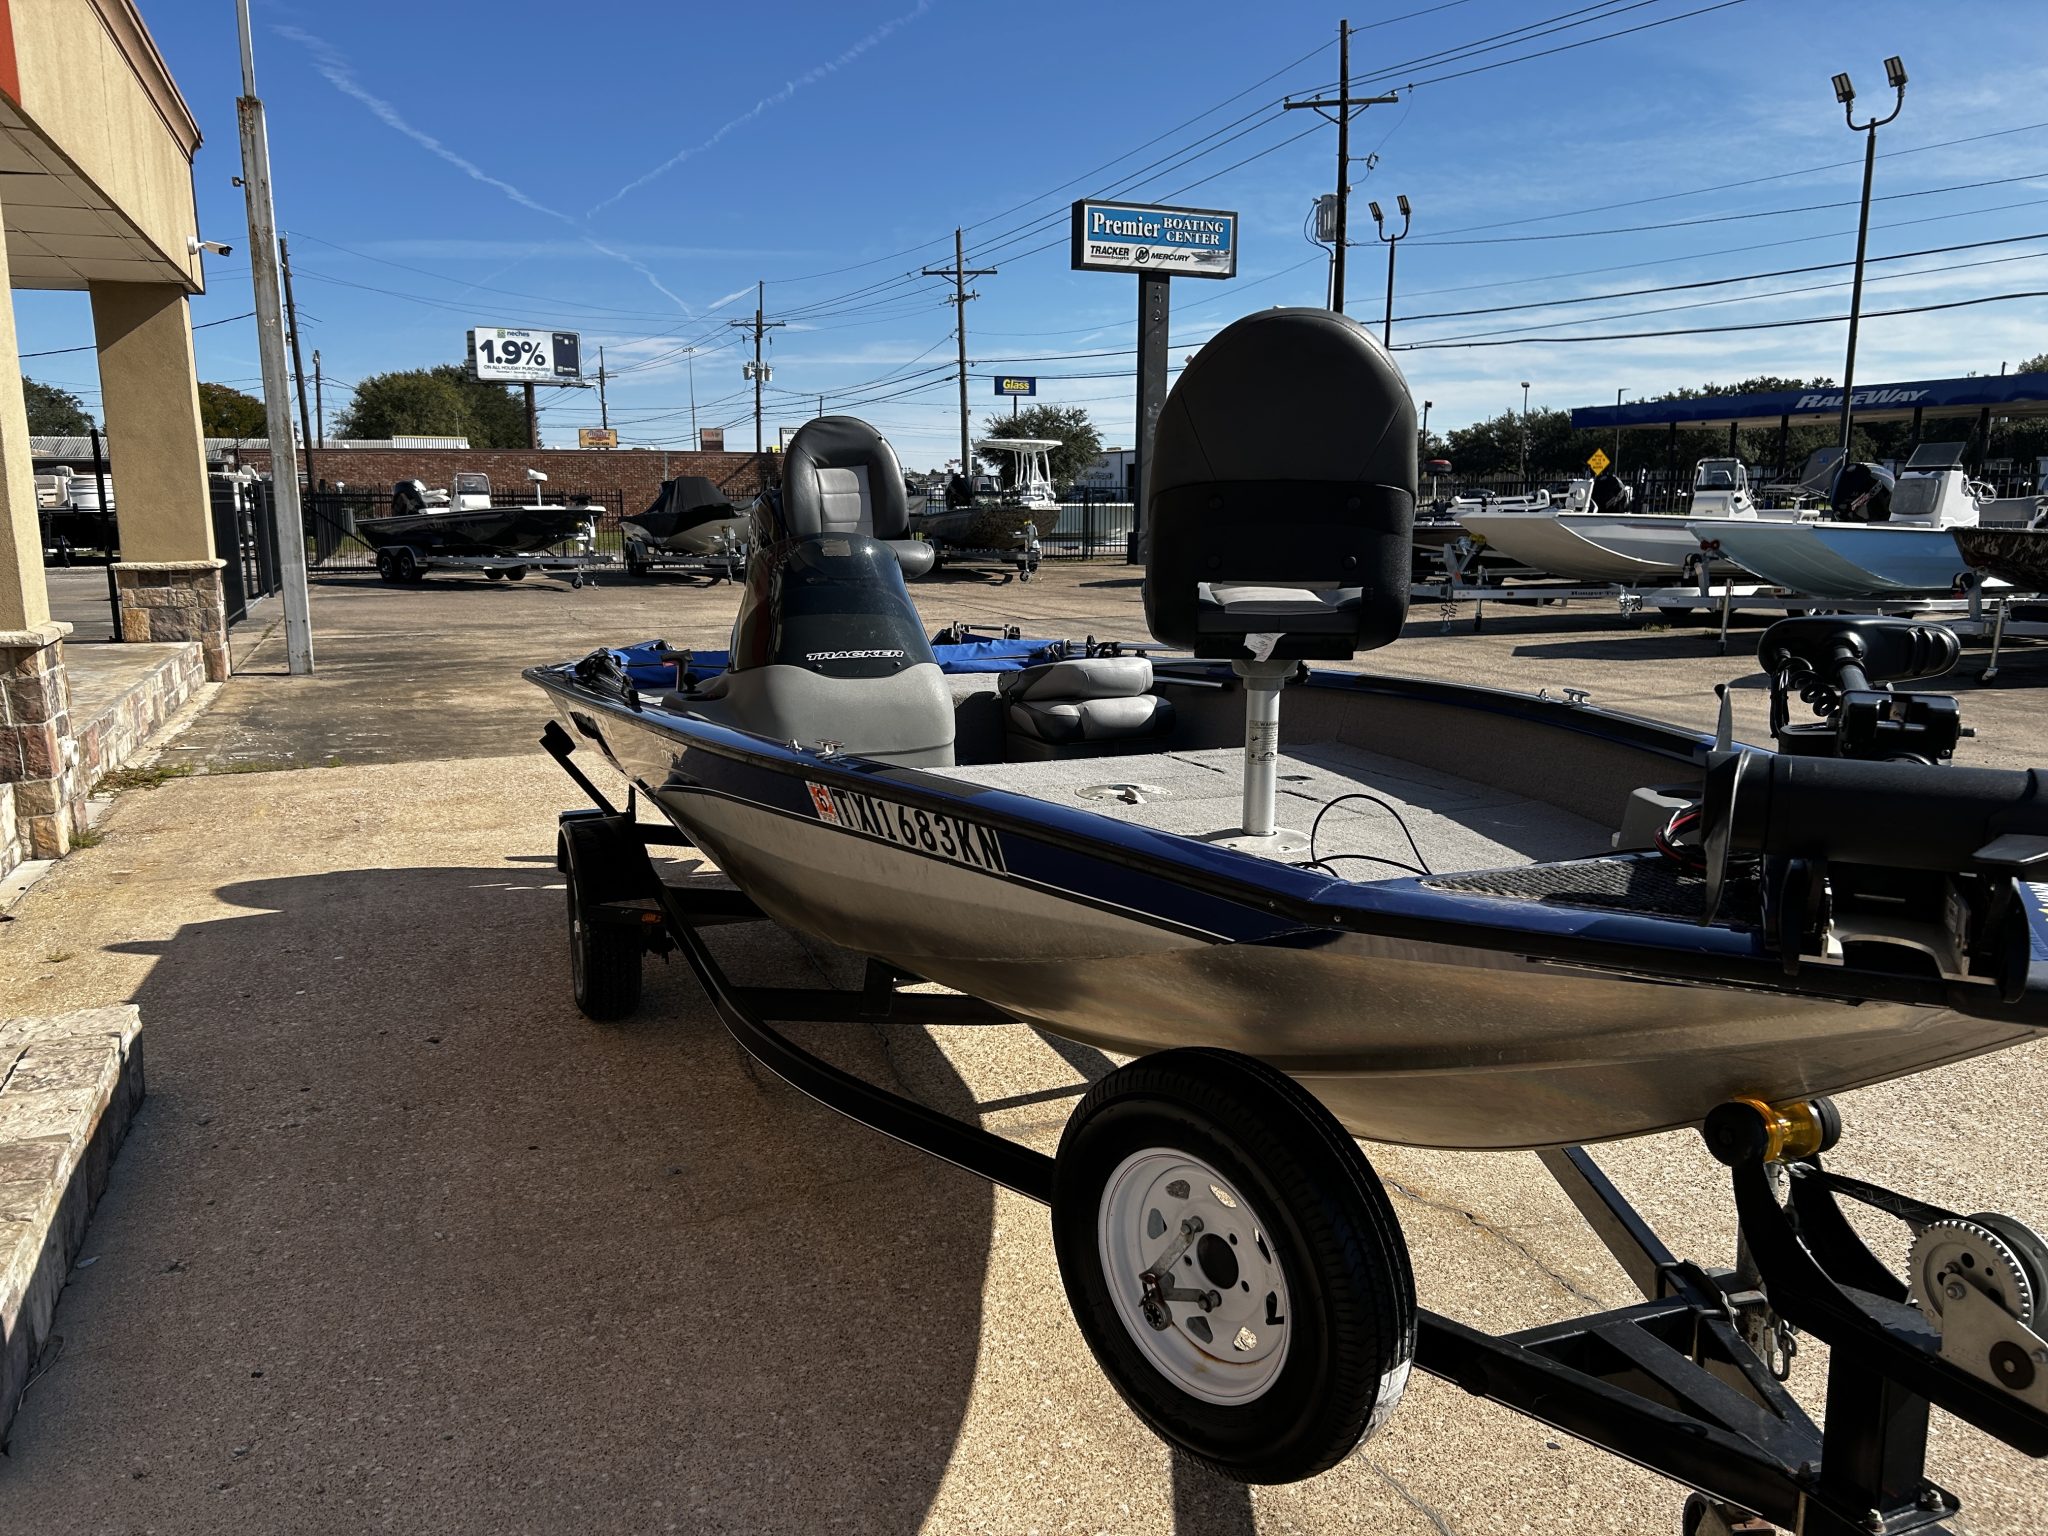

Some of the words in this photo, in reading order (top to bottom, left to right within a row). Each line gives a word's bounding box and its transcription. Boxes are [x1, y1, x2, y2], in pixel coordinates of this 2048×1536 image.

[1092, 212, 1160, 238] Premier
[1163, 217, 1224, 233] BOATING
[1166, 231, 1220, 245] CENTER
[1090, 245, 1129, 257] TRACKER
[1151, 252, 1190, 262] MERCURY
[507, 330, 530, 338] neches
[479, 339, 546, 366] 1.9%
[1003, 378, 1030, 390] Glass
[806, 650, 904, 661] TRACKER
